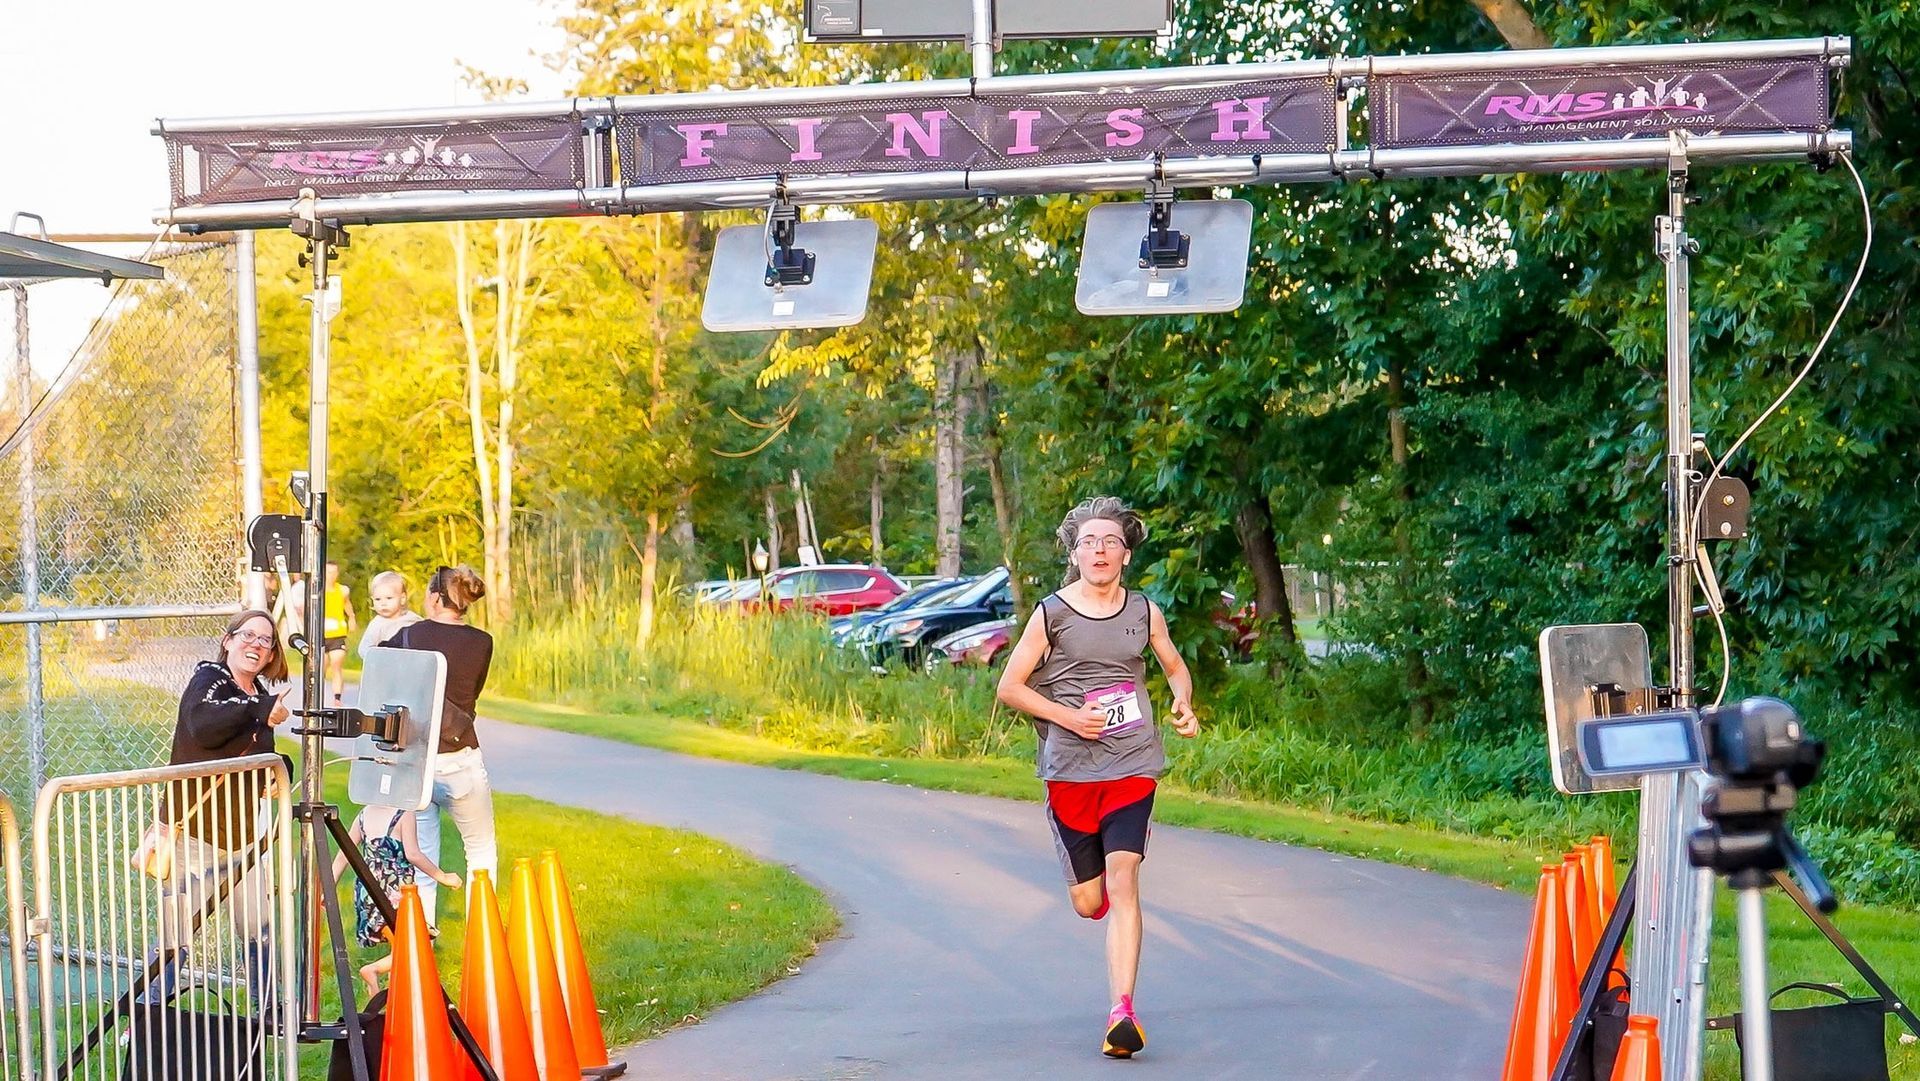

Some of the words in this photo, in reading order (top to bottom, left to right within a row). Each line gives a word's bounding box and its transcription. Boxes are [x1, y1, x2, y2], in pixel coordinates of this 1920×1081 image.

[1484, 91, 1608, 120] RMS
[677, 96, 1271, 167] FINISH
[1519, 119, 1629, 133] MANAGEMENT
[1634, 114, 1716, 127] SOLUTIONS
[302, 173, 400, 185] MANAGEMENT
[1106, 704, 1125, 727] 28
